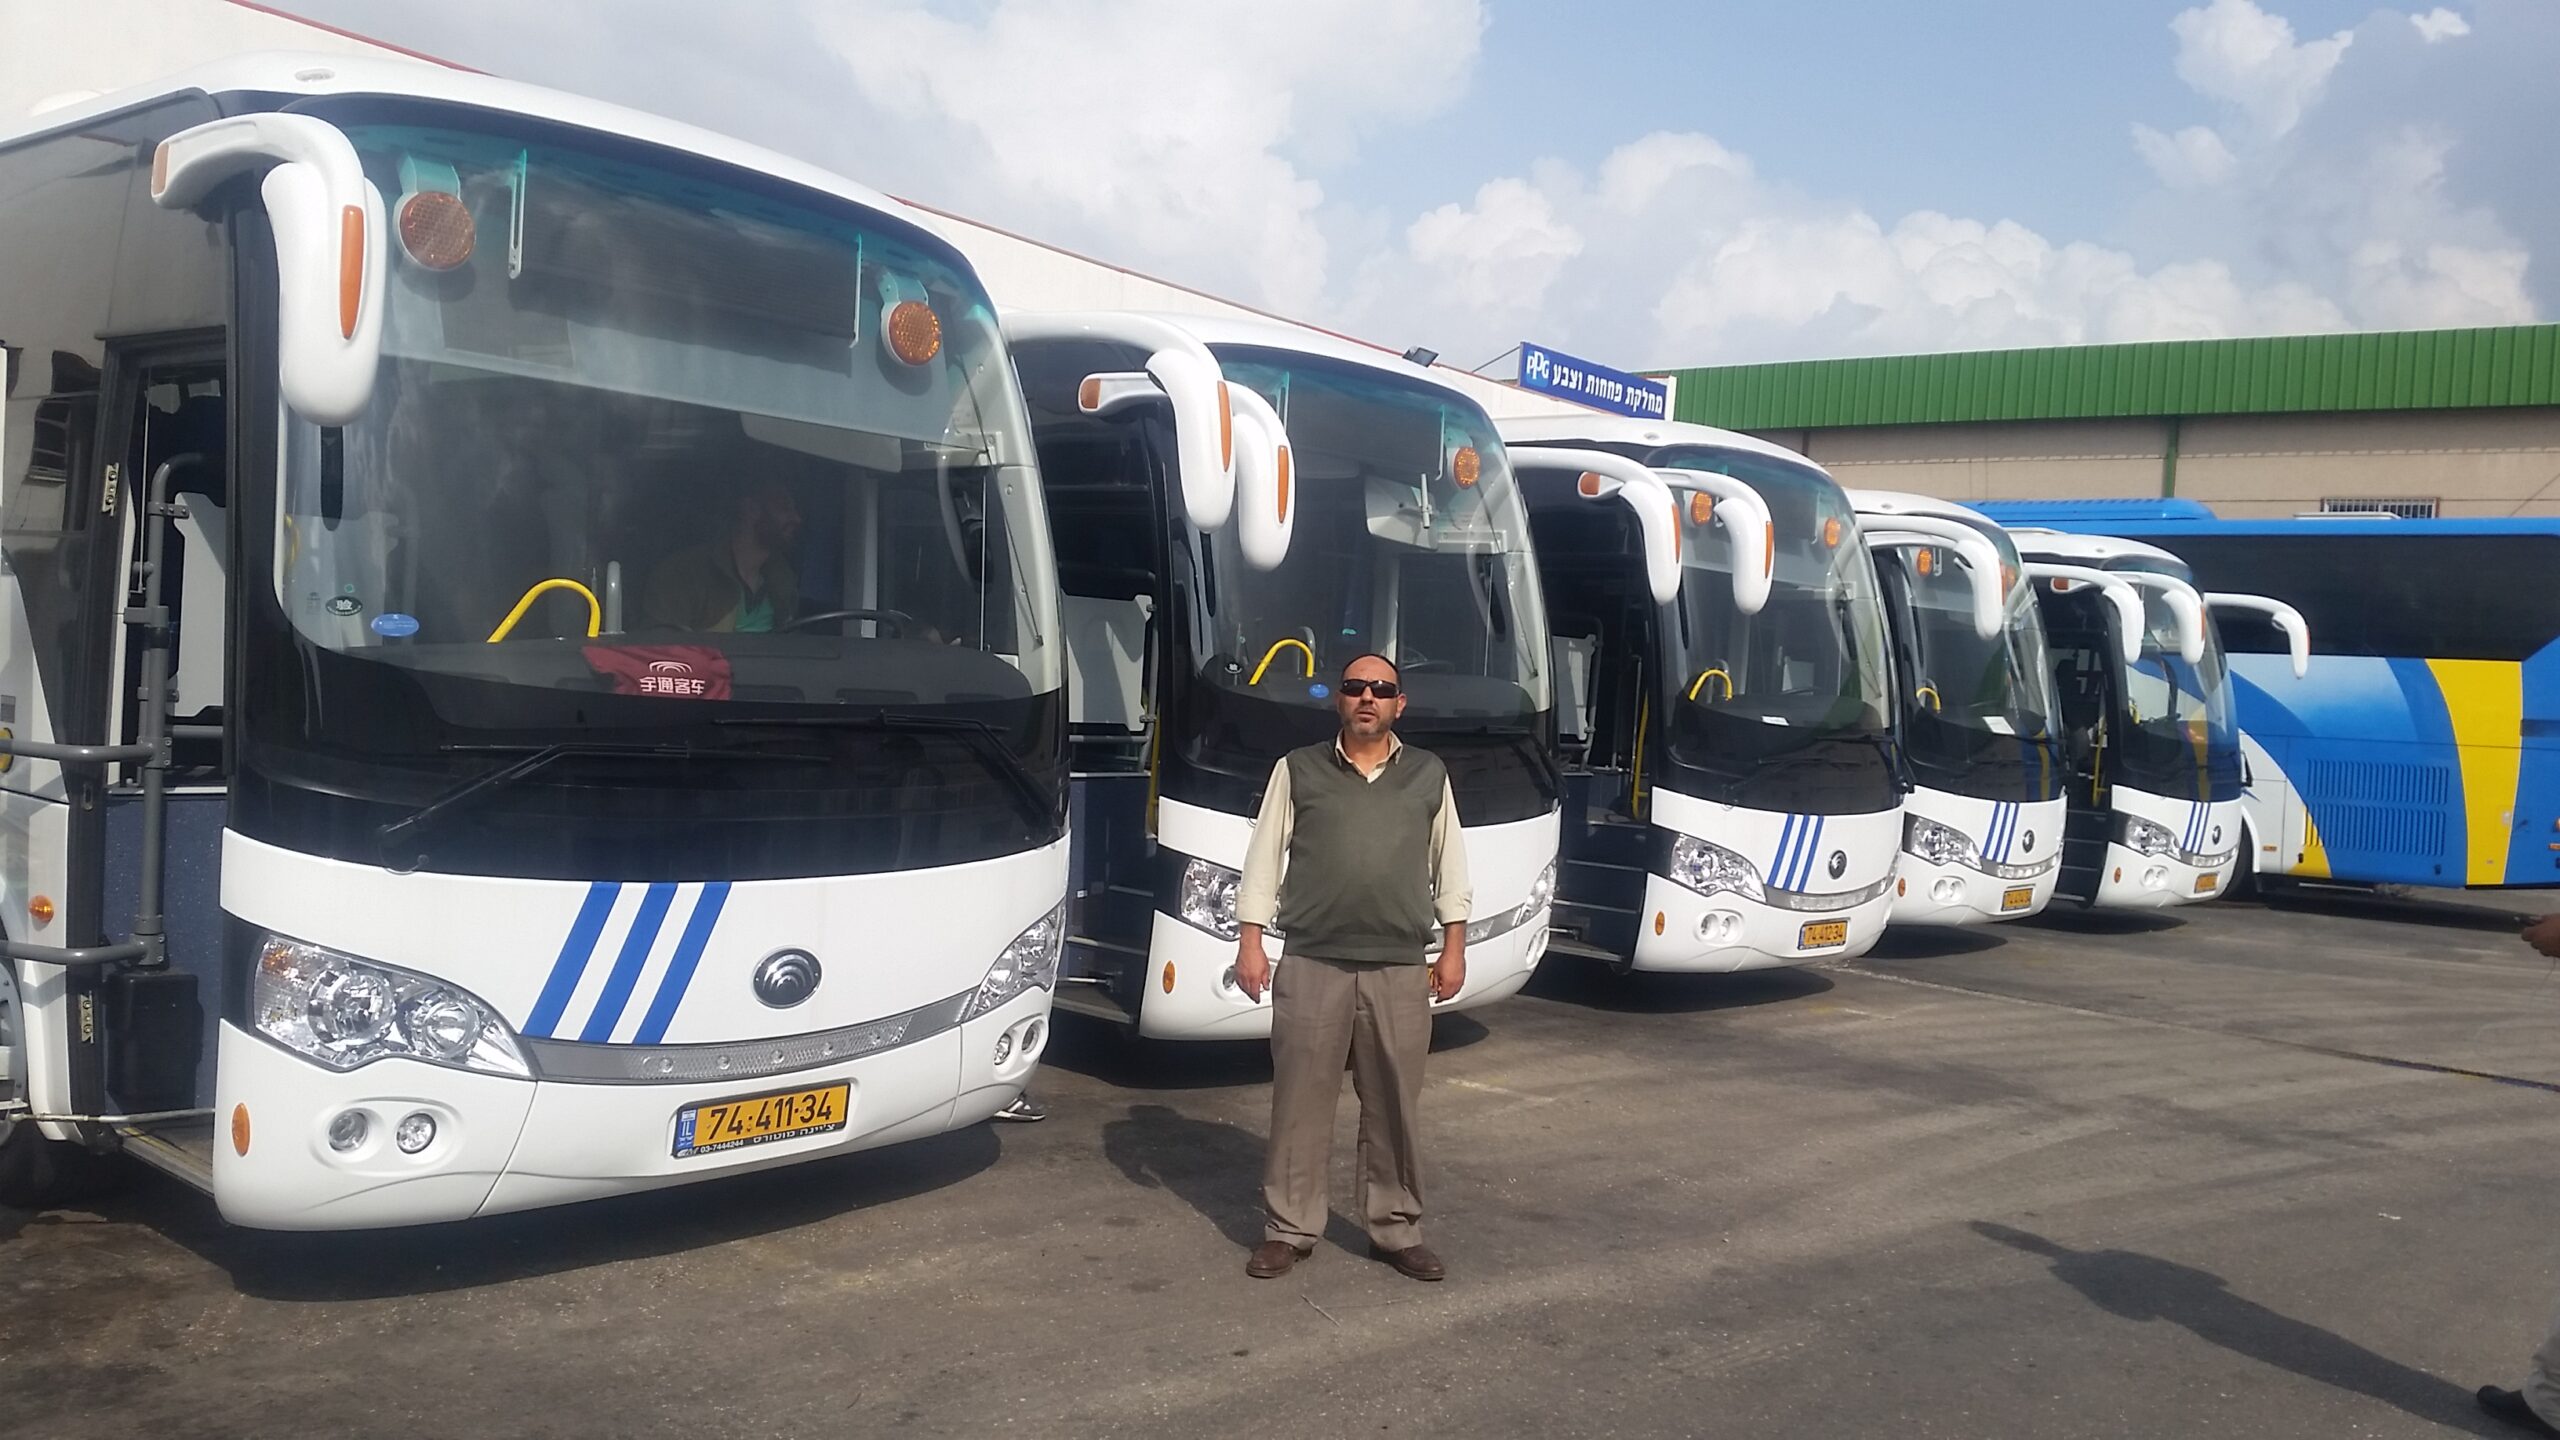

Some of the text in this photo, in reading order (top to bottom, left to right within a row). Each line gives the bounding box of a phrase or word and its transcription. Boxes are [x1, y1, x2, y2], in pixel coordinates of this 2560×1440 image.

[1526, 351, 1550, 380] PPG
[1552, 364, 1663, 414] מחלקת פחחות וצבע
[639, 676, 706, 695] 宇通客车
[753, 1130, 796, 1144] מוטורס
